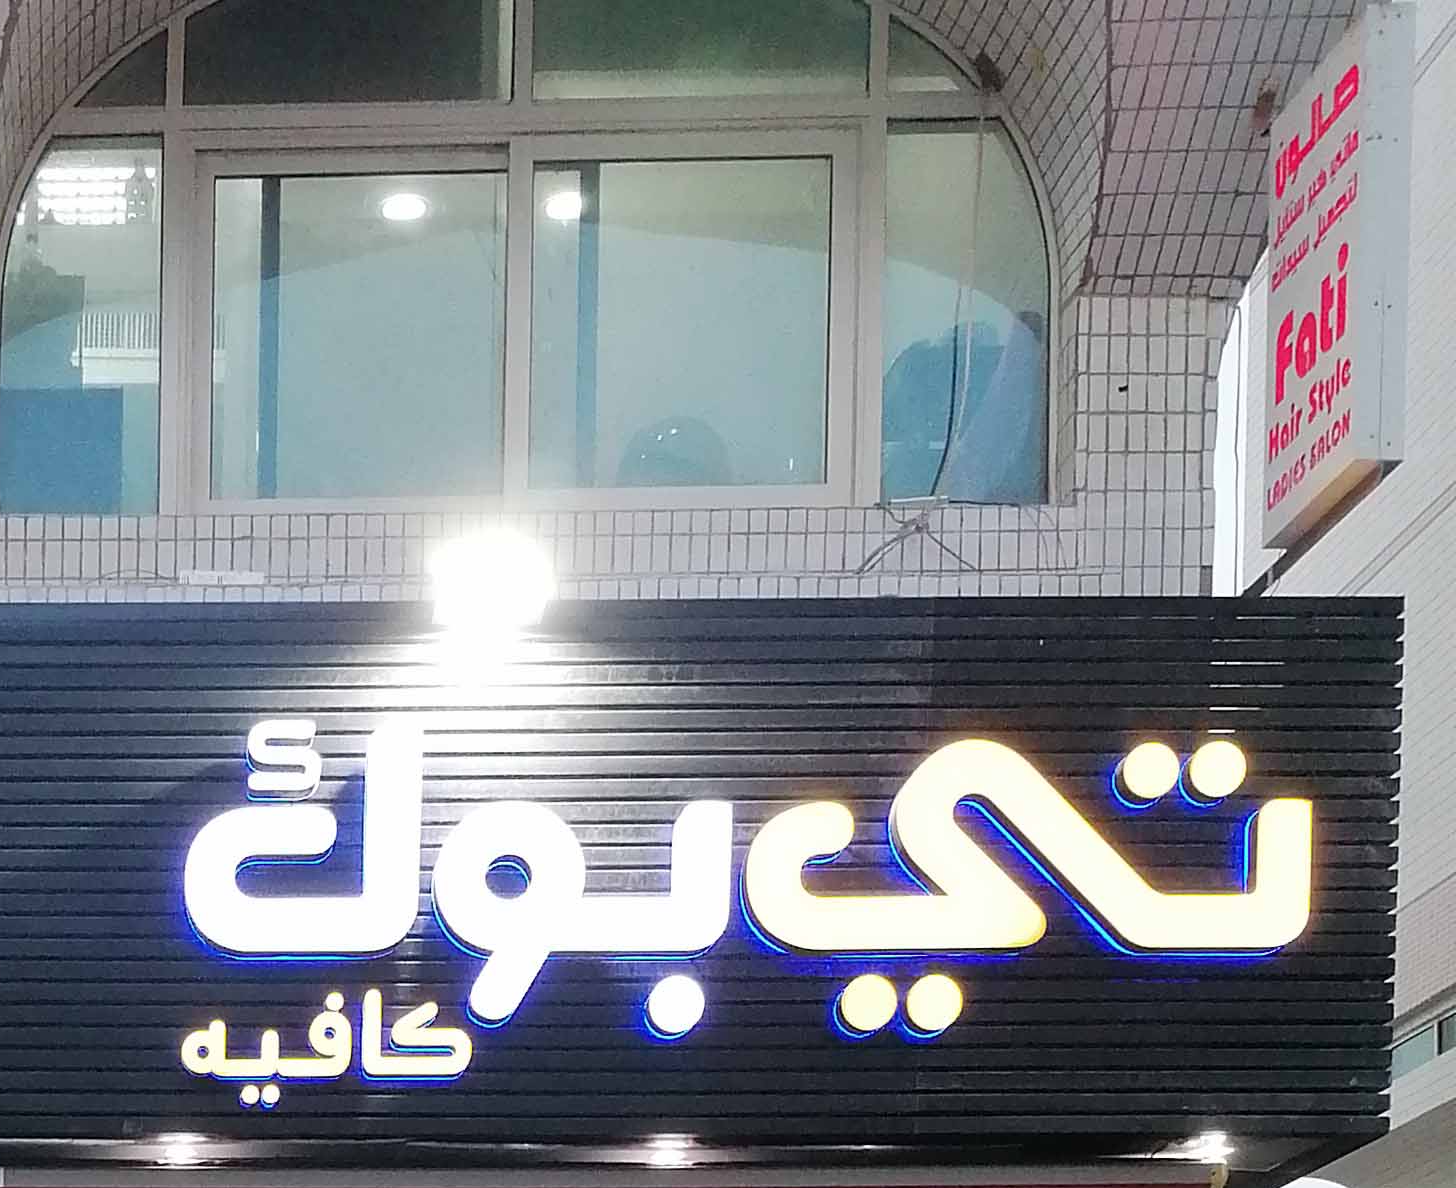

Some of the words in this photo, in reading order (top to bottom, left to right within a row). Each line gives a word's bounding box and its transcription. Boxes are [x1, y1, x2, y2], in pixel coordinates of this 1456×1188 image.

[1275, 242, 1349, 406] Fati
[1267, 453, 1306, 512] LADIES
[1309, 408, 1351, 470] SALON
[1268, 403, 1303, 465] Hair
[1308, 358, 1351, 424] Style
[184, 718, 735, 1040] بوك
[742, 738, 1312, 1038] تي
[180, 989, 473, 1108] كافيه
